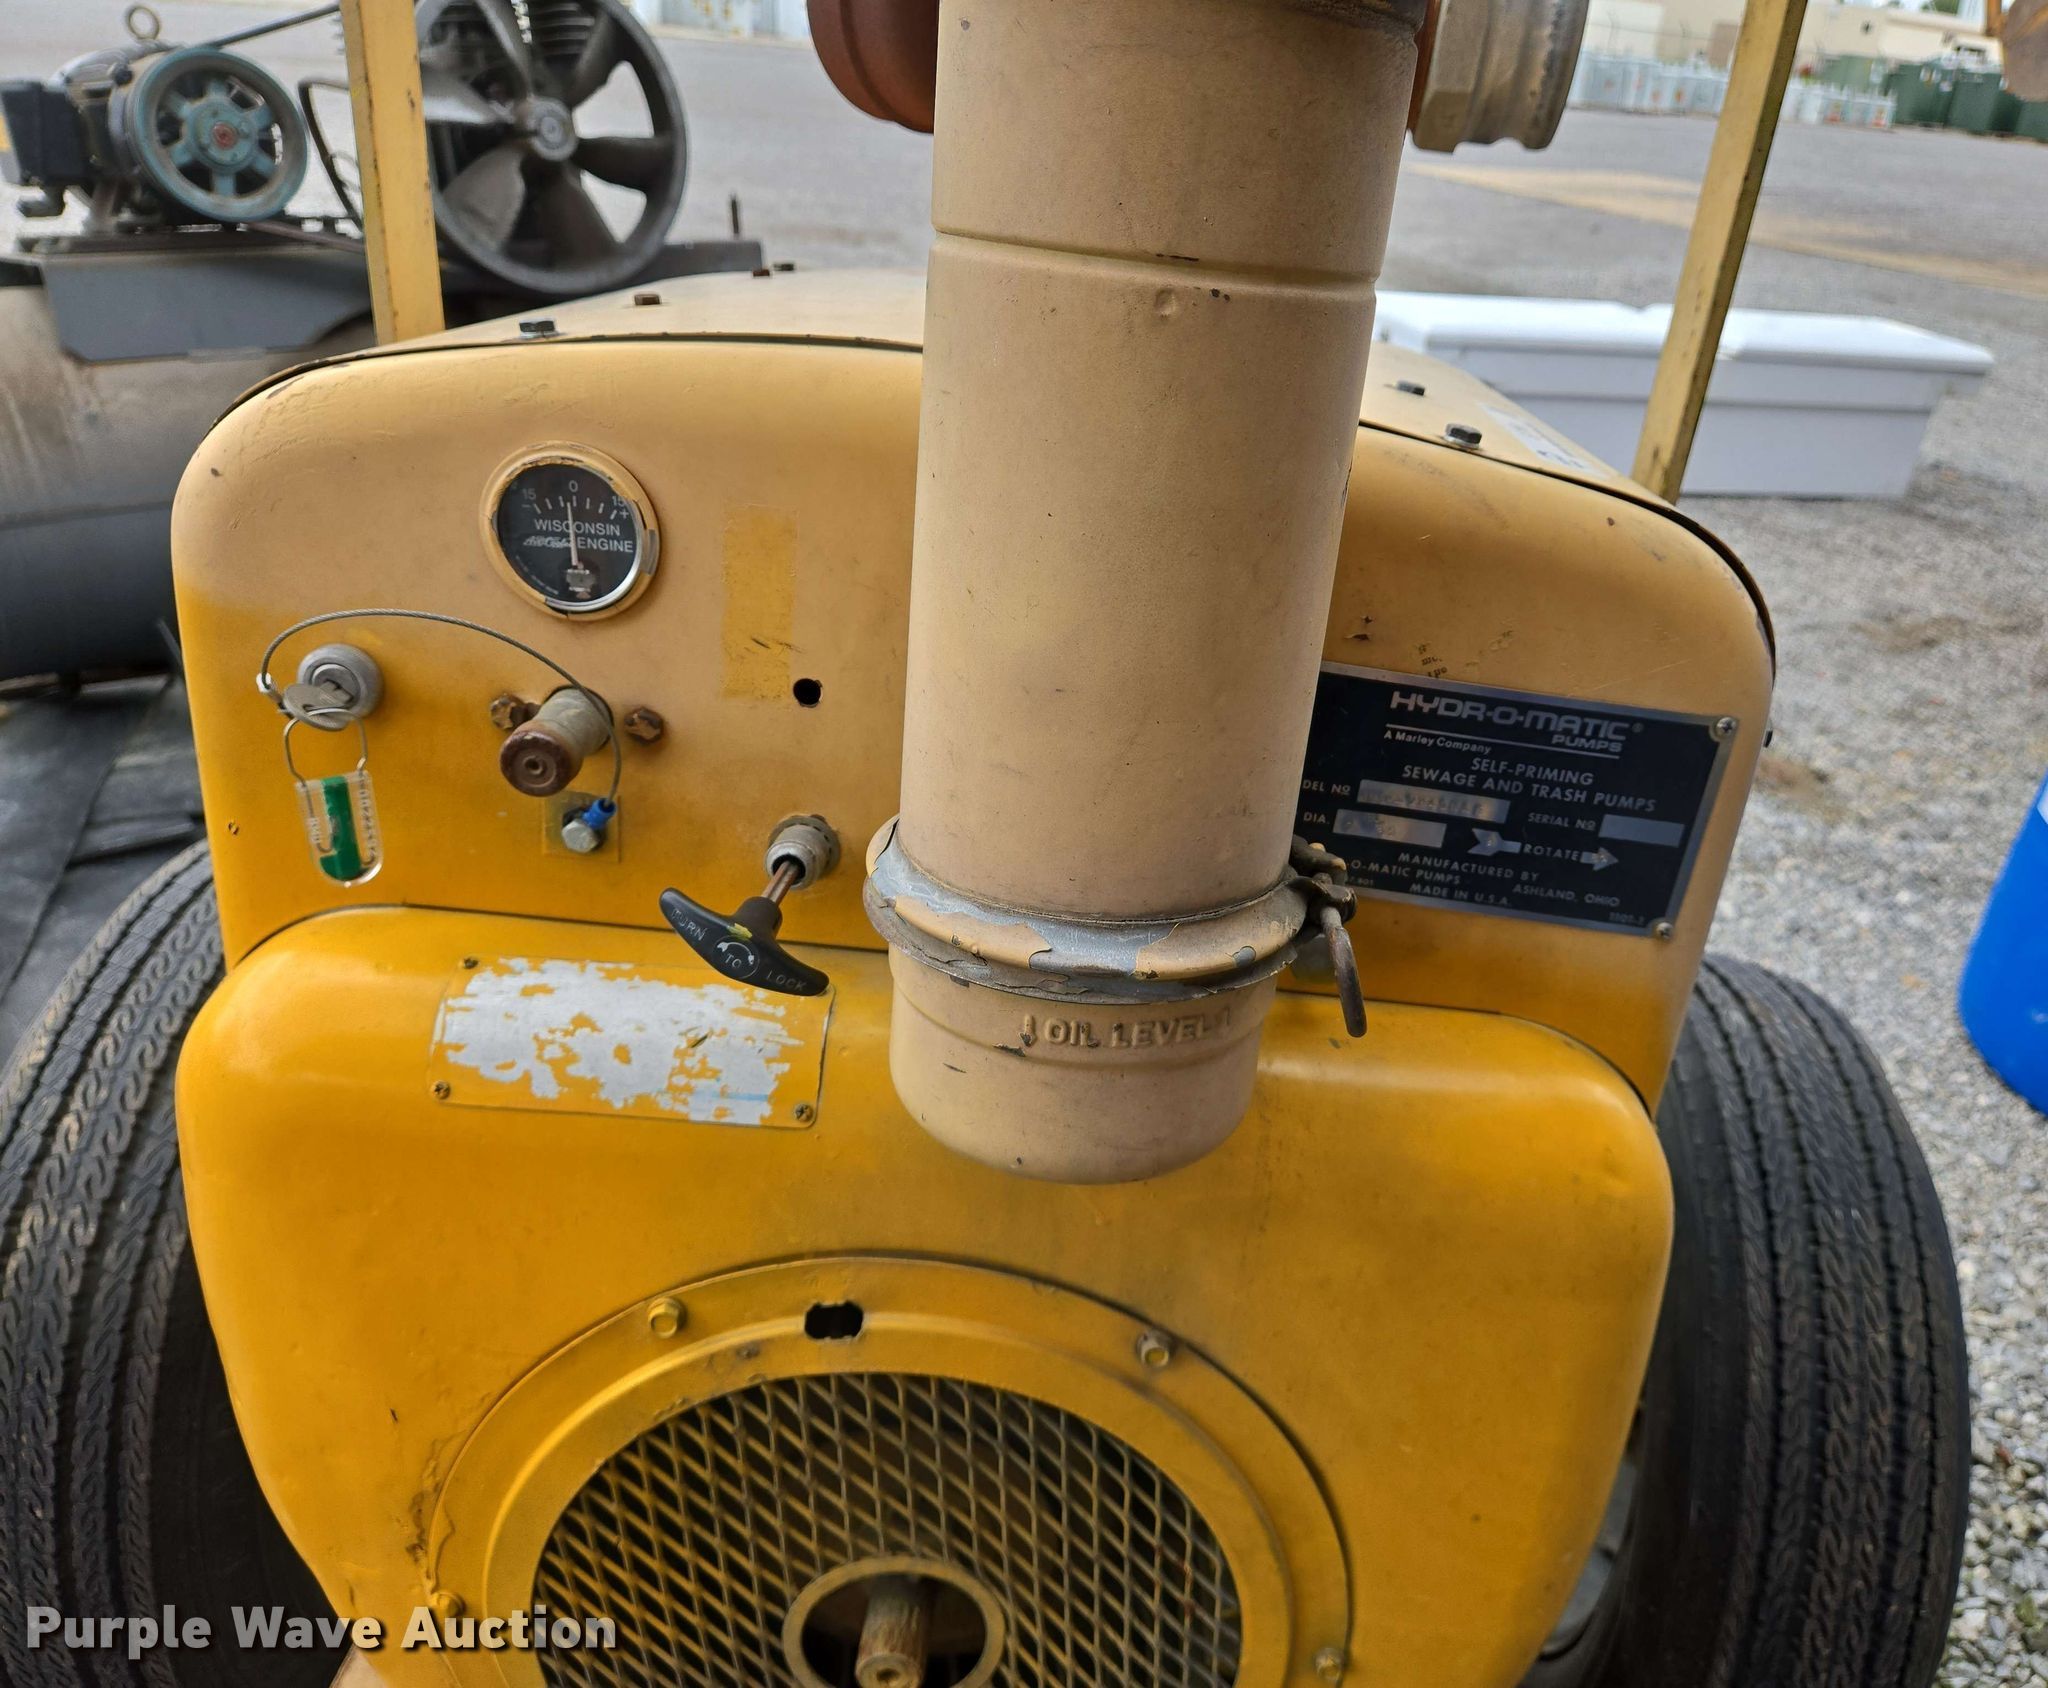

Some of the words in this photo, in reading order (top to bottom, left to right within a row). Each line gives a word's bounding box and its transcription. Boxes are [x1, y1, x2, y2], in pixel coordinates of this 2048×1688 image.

[522, 488, 536, 500] 15
[568, 480, 578, 493] 0
[534, 518, 621, 536] WISCONSIN
[577, 537, 634, 553] ENGINE
[1389, 691, 1629, 740] HYDR-O-MATIC
[1384, 730, 1393, 739] A
[1395, 731, 1435, 747] Marley
[1436, 737, 1492, 755] Company
[1551, 734, 1622, 753] PUMPS
[1471, 757, 1594, 786] SELF-PRIMING
[1302, 779, 1325, 791] DEL
[1401, 765, 1477, 788] SEWAGE
[1482, 777, 1524, 795] AND
[1531, 784, 1588, 803] TRASH
[1593, 792, 1657, 812] PUMPS
[1528, 812, 1569, 828] SERIAL
[1523, 843, 1580, 861] ROTATE
[1398, 852, 1515, 878] MANUFACTURED
[1520, 871, 1540, 882] BY
[1409, 883, 1449, 898] MADE
[1454, 889, 1470, 899] IN
[1415, 869, 1461, 885] PUMPS
[1584, 893, 1620, 907] OHIO
[671, 908, 706, 942] TURN
[724, 953, 742, 969] TO
[766, 970, 807, 992] LOCK
[1044, 1017, 1099, 1048] OIL
[1111, 1015, 1211, 1048] LEVEL
